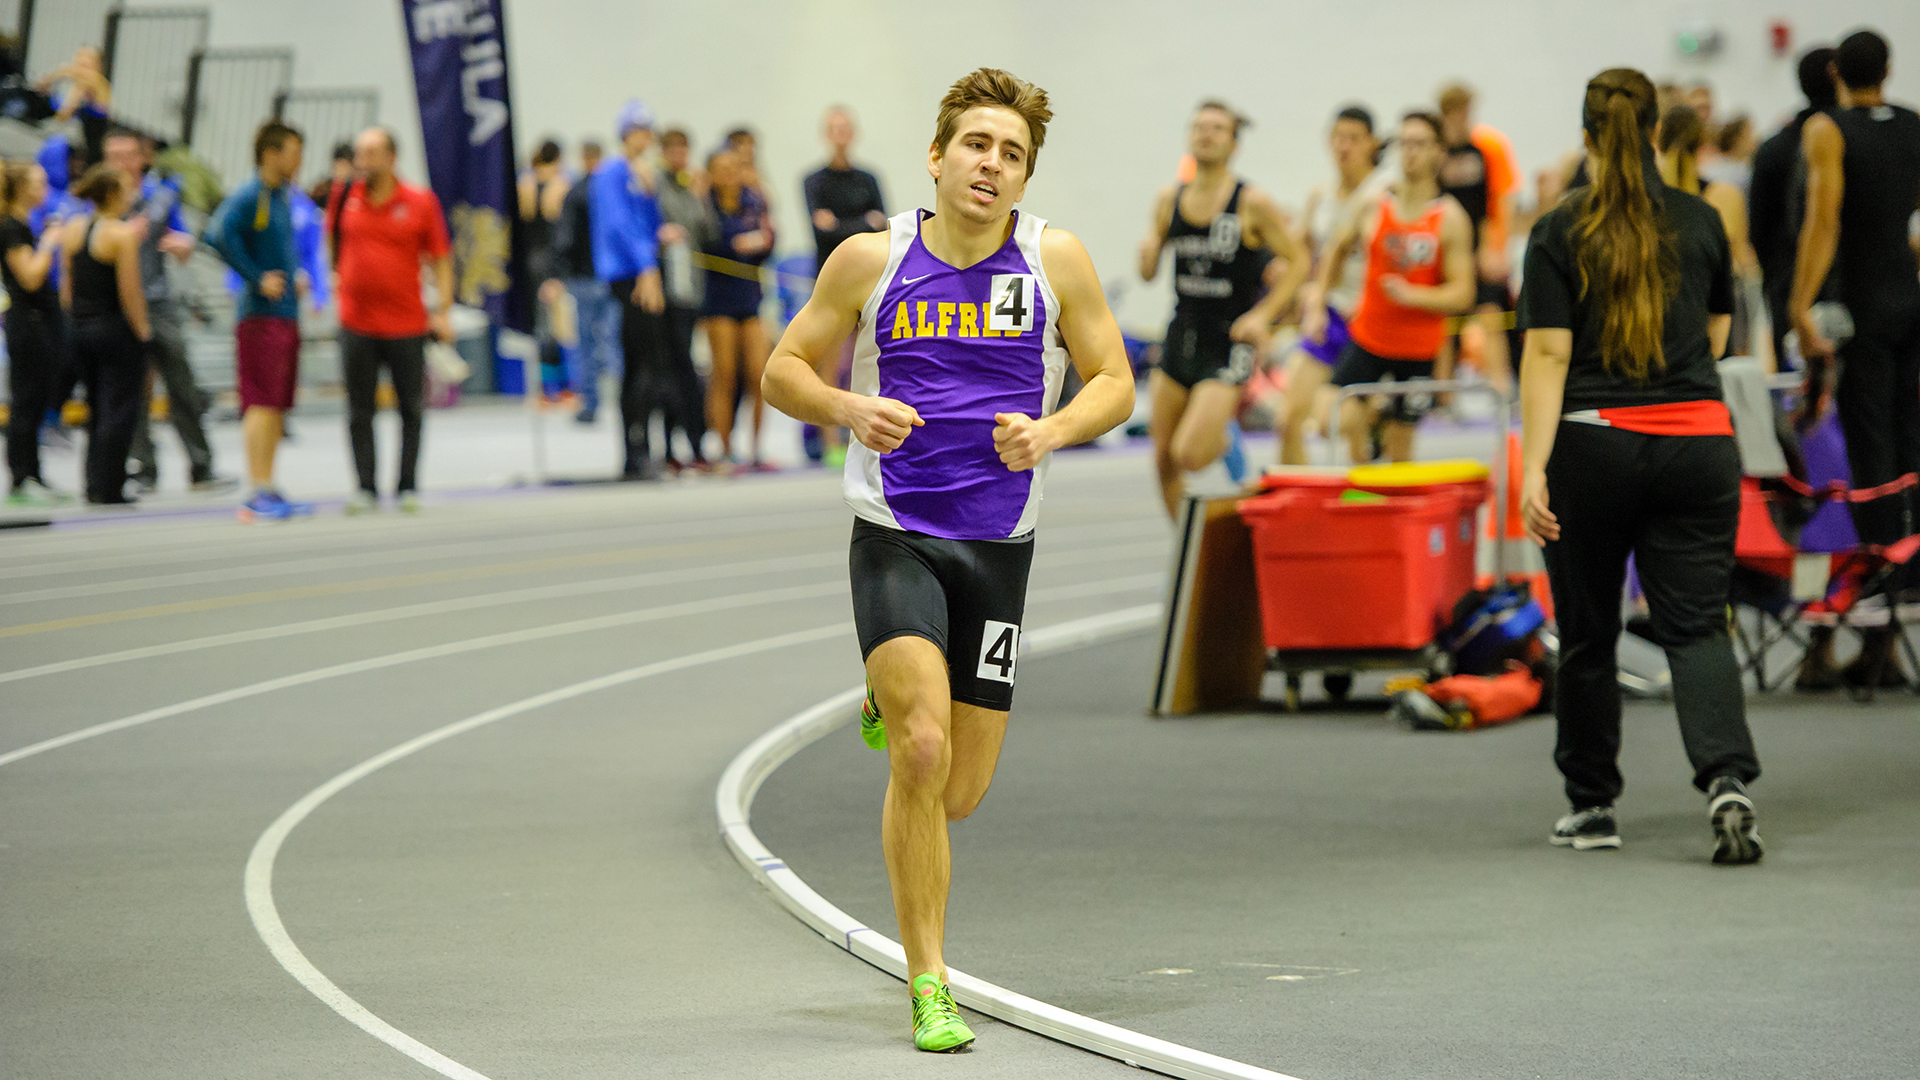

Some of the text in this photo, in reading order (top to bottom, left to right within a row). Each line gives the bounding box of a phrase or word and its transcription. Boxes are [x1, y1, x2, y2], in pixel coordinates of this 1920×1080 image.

[892, 301, 1022, 339] ALFR
[995, 277, 1027, 326] 4
[984, 626, 1014, 678] 4
